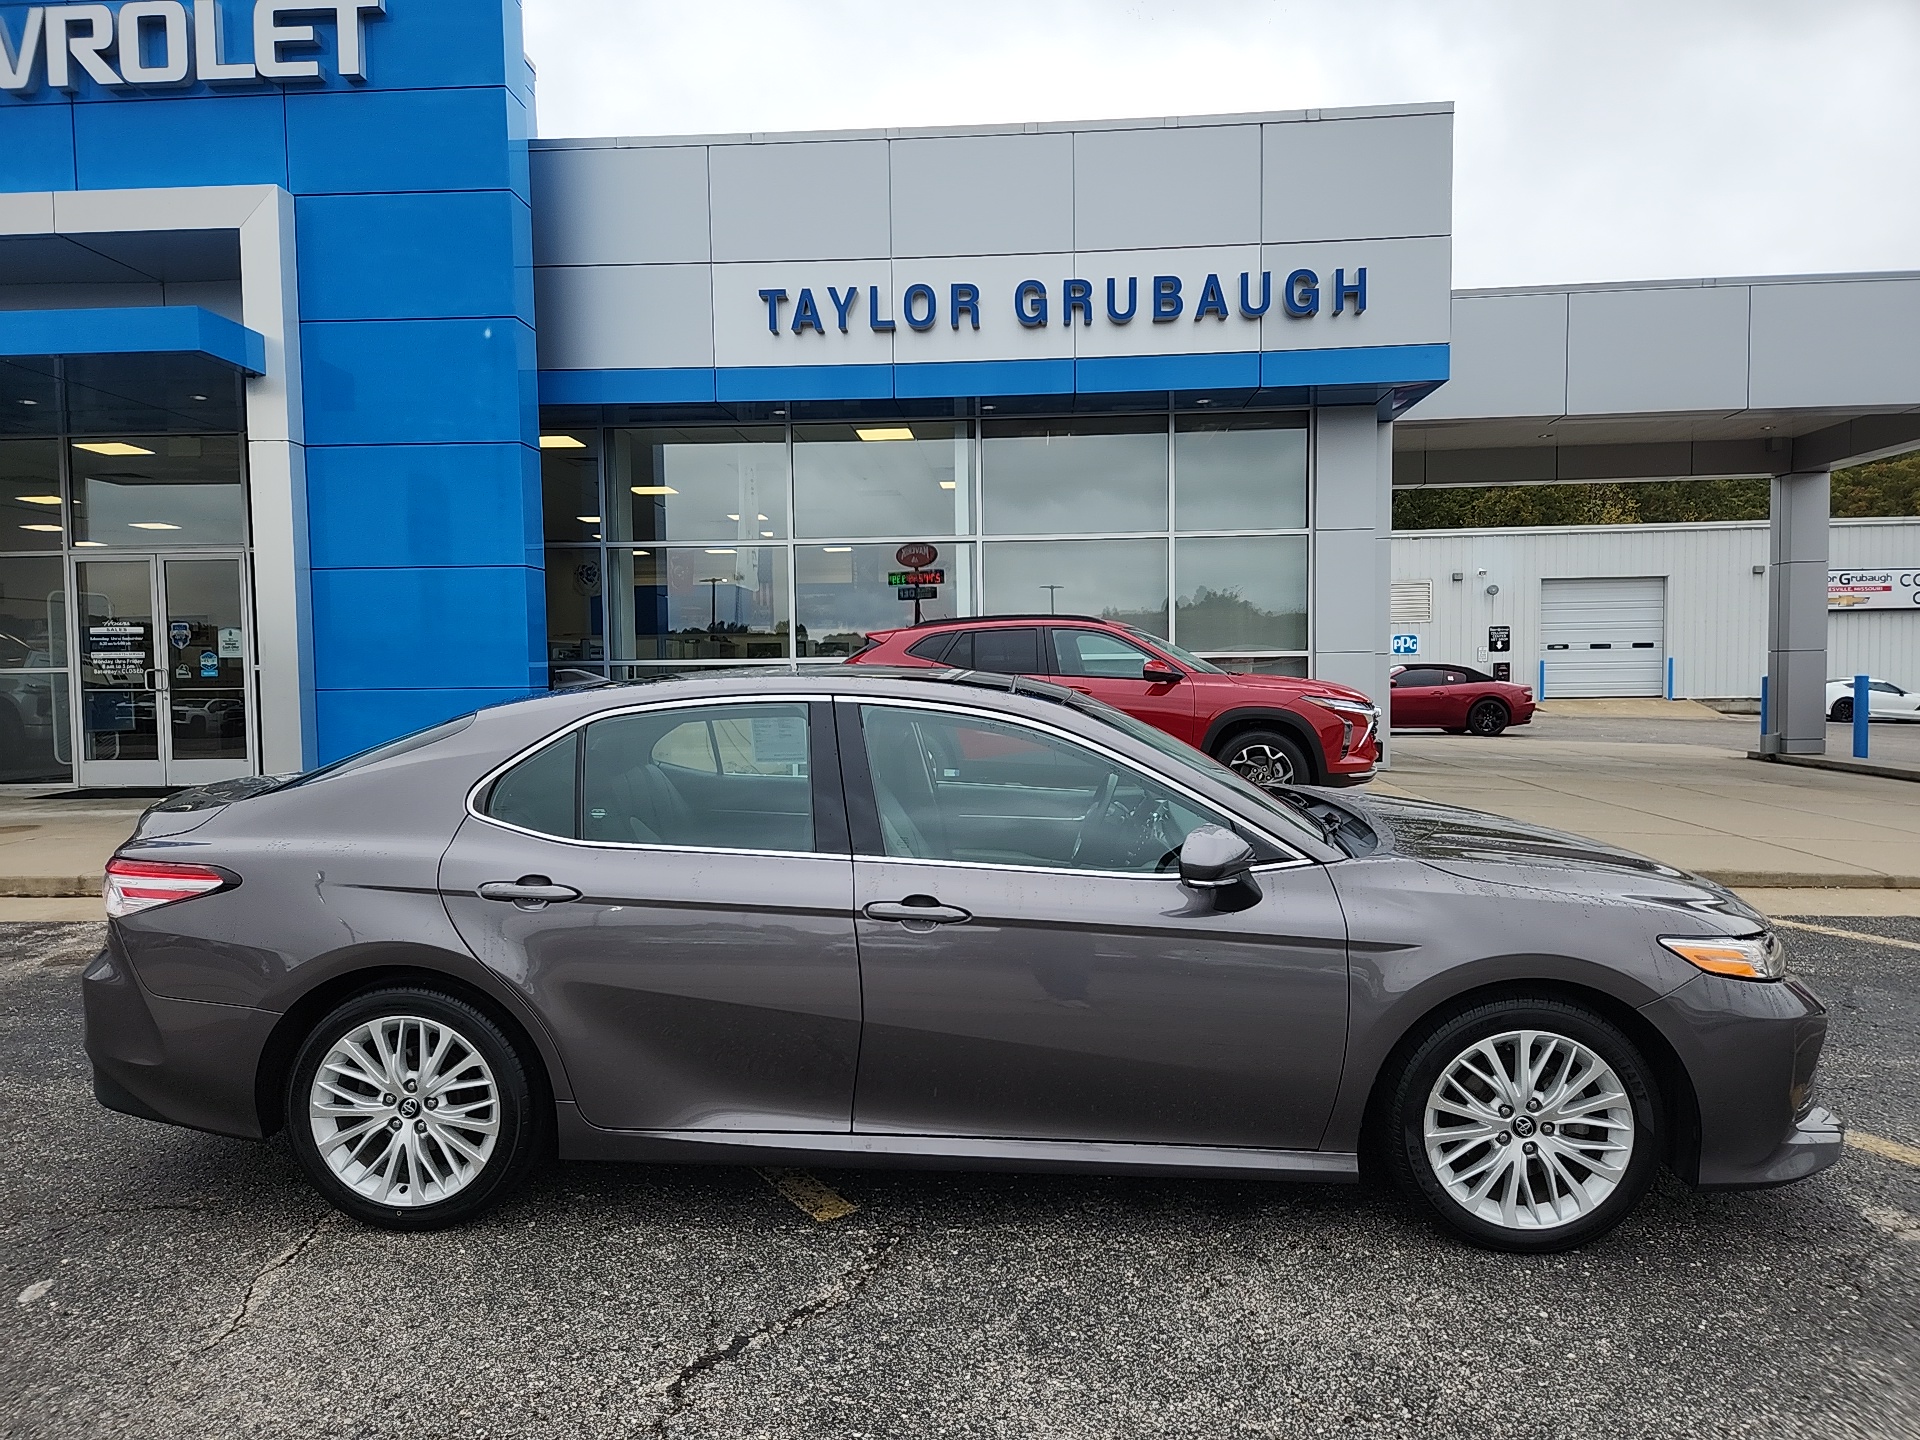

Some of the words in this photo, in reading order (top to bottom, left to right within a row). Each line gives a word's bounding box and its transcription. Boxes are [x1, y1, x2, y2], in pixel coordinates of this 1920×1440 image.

[758, 282, 981, 335] TAYLOR
[1014, 267, 1368, 328] GRUBAUGH
[1839, 573, 1892, 585] Grubaugh
[1394, 636, 1417, 653] PPG
